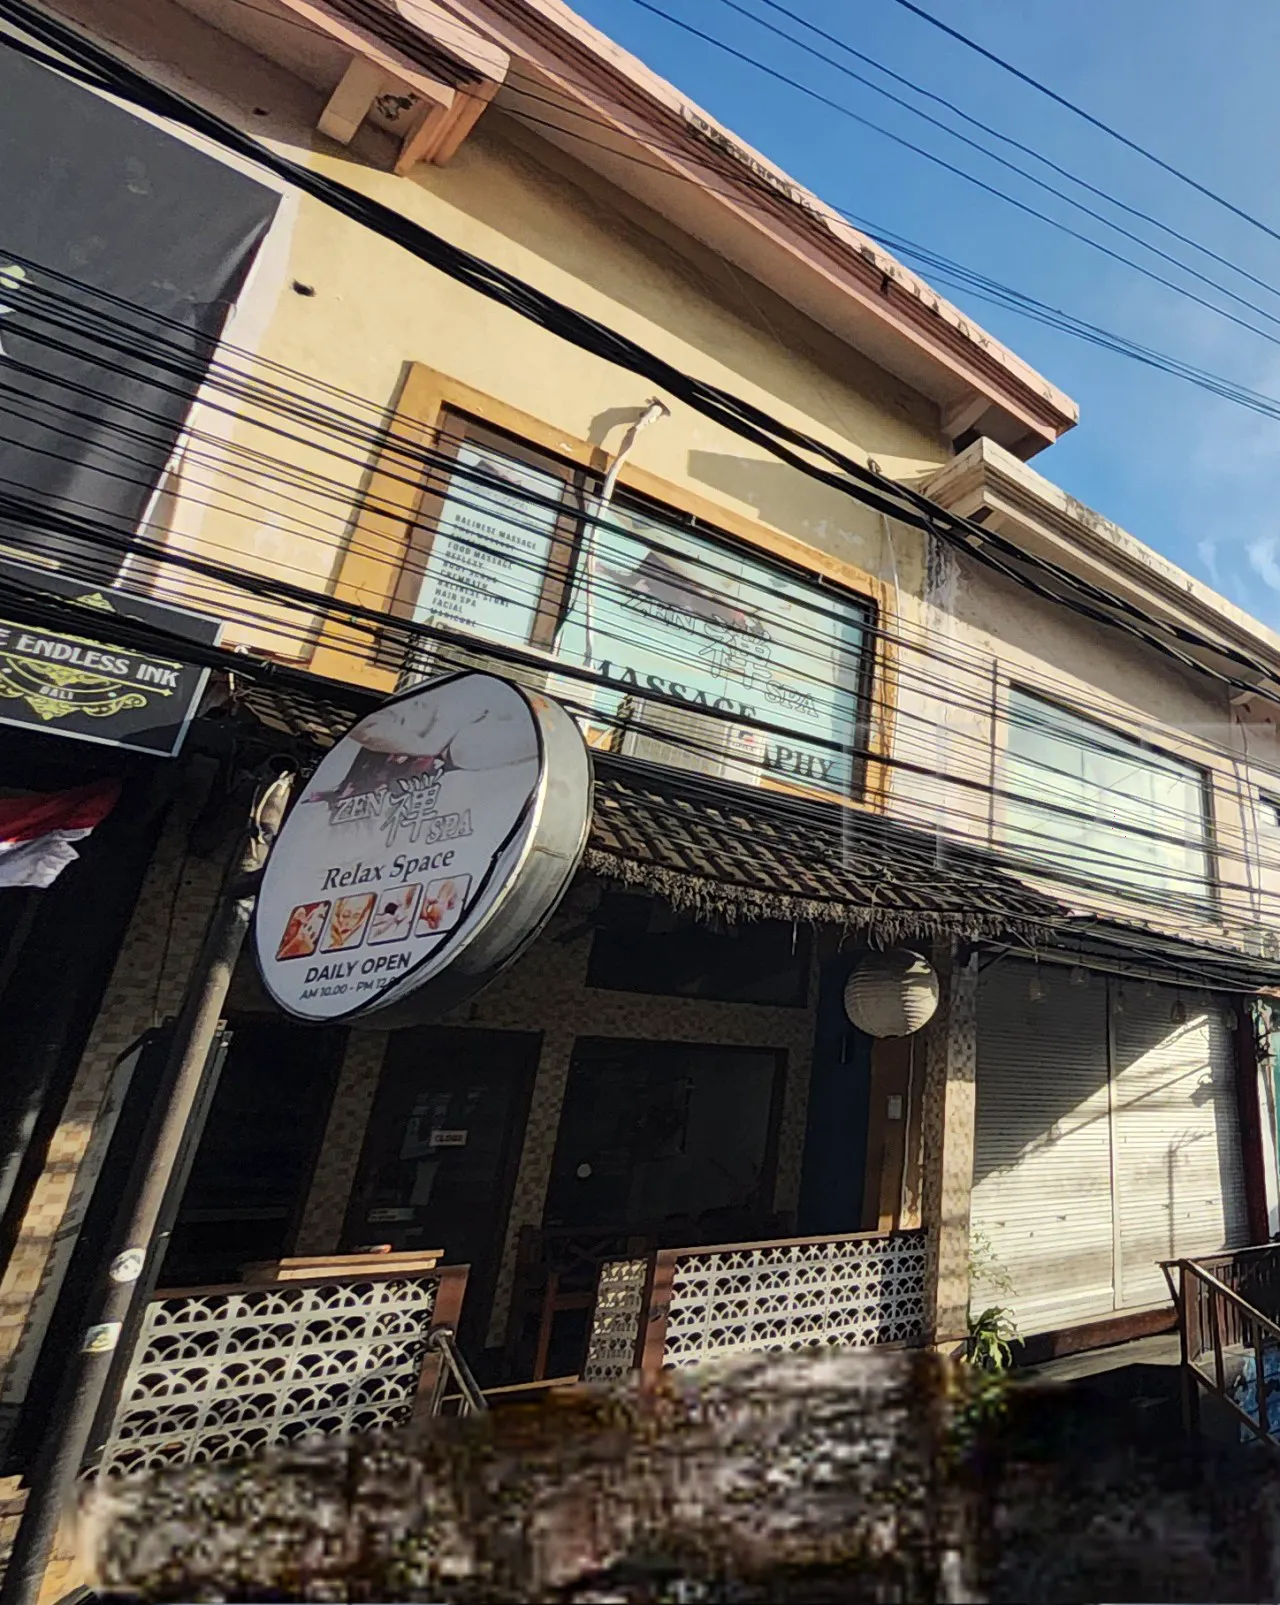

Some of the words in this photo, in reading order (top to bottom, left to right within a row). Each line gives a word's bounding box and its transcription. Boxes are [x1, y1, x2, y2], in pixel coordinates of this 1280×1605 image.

[499, 530, 537, 551] MASSAGE
[432, 597, 464, 615] FACIAL
[434, 588, 459, 603] HAIR
[459, 595, 477, 608] SPA
[16, 634, 130, 675] ENDLESS
[136, 663, 180, 688] INK
[39, 686, 74, 700] BALI
[764, 679, 819, 718] SPA
[329, 788, 392, 825] ZEN
[425, 809, 473, 845] SPA
[321, 864, 384, 891] Relax
[389, 849, 455, 881] Space
[303, 962, 359, 984] DAILY
[361, 951, 412, 975] OPEN
[299, 988, 318, 1000] AM
[356, 979, 374, 992] PM
